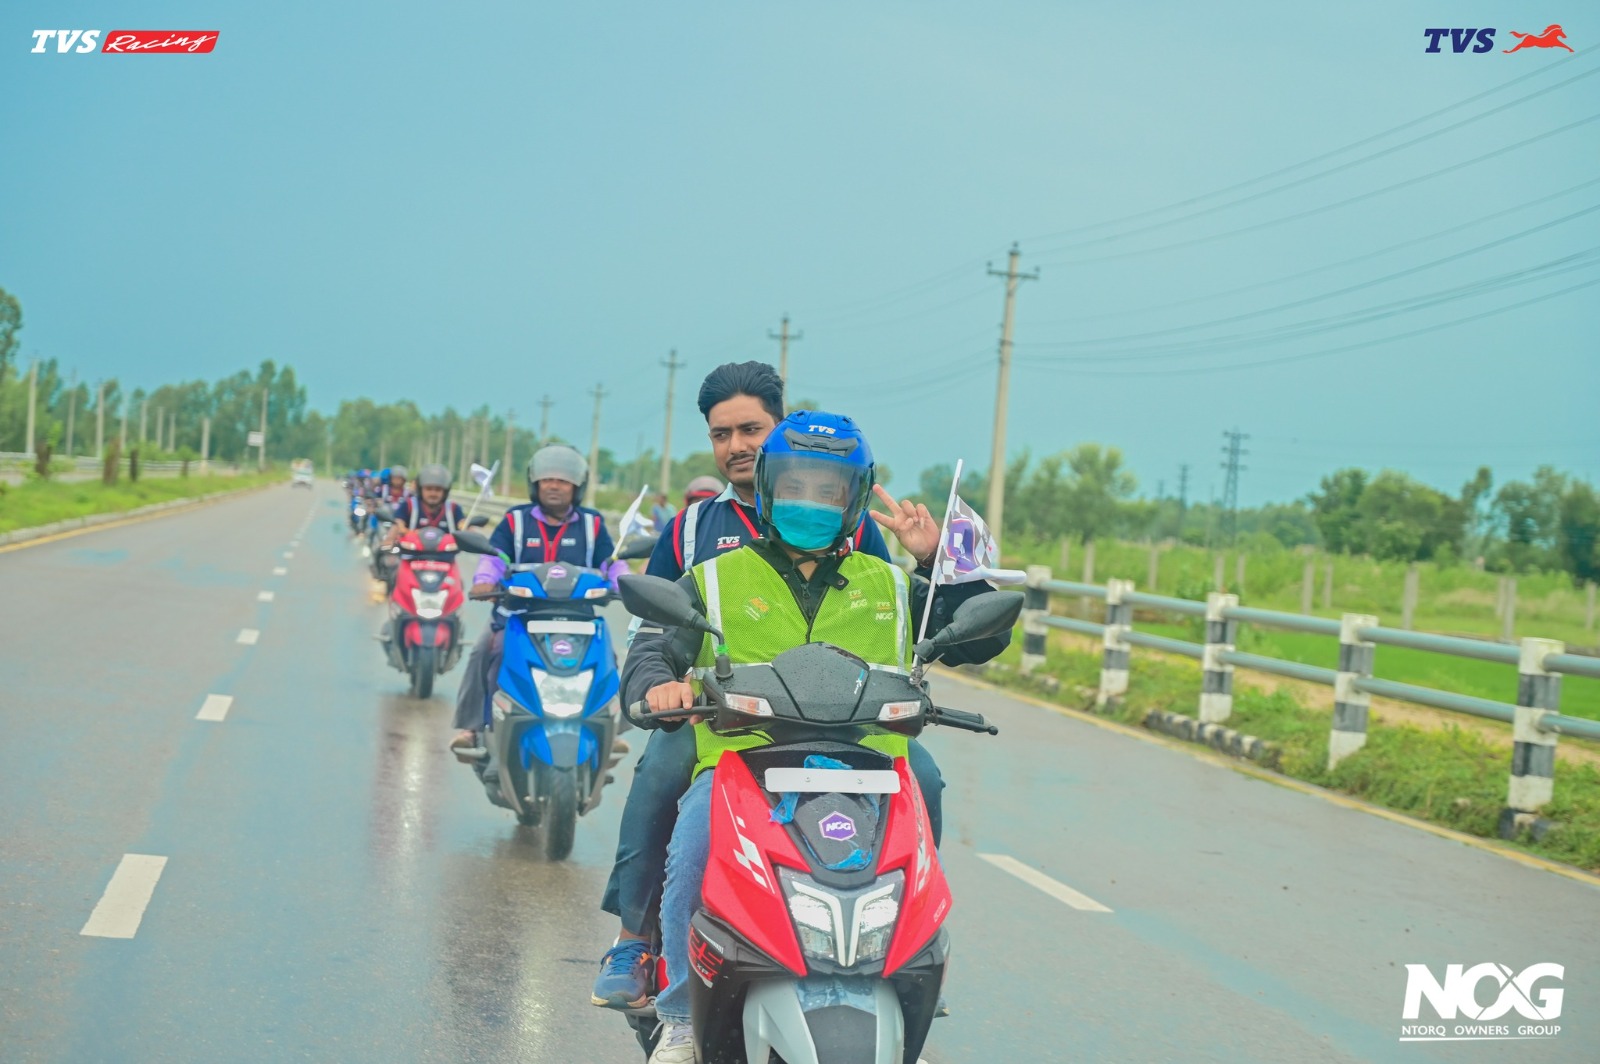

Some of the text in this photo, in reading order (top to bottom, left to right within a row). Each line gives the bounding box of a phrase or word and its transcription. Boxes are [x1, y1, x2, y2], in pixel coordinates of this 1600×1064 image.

[808, 424, 836, 434] TVS
[717, 536, 740, 545] TVS
[875, 612, 894, 620] NOG
[825, 821, 852, 832] NOG
